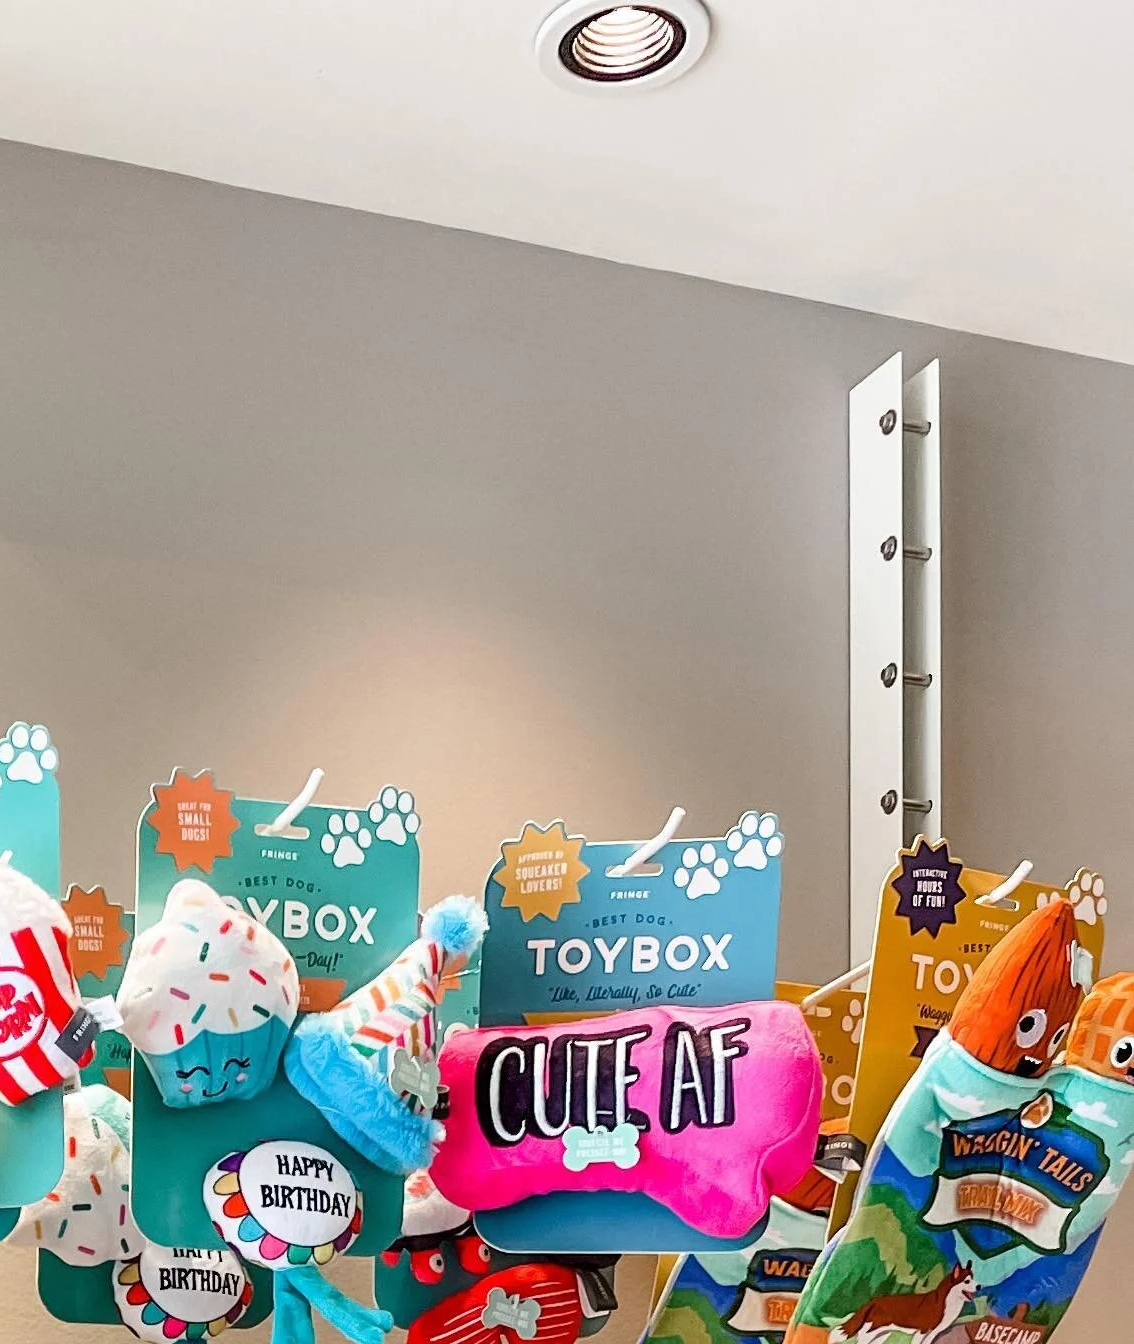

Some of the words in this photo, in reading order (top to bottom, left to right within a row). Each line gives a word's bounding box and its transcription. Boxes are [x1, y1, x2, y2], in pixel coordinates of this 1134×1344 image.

[177, 812, 212, 827] SMALL
[181, 826, 210, 841] DOGS!
[261, 849, 297, 861] FRINGE
[515, 863, 568, 881] SQUEAKER
[245, 875, 277, 887] BEST
[286, 877, 316, 893] DOG
[520, 877, 563, 894] LOVERS!
[916, 880, 943, 894] HOURS
[610, 889, 650, 900] FRINGE
[912, 895, 924, 908] OF
[926, 895, 946, 908] FUN!
[592, 914, 627, 928] BEST
[635, 913, 666, 926] DOG
[75, 925, 104, 939] SMALL
[78, 938, 103, 952] DOGS!
[963, 943, 991, 953] BEST
[527, 934, 733, 976] TOYBOX
[645, 983, 663, 999] So
[484, 1028, 651, 1145] CUTE
[668, 1020, 750, 1130] AF
[276, 1154, 335, 1182] HAPPY
[953, 1130, 1041, 1161] WAGGIN'
[1037, 1146, 1095, 1192] TAILS
[260, 1185, 352, 1219] BIRTHDAY
[159, 1268, 240, 1297] BIRTHDAY
